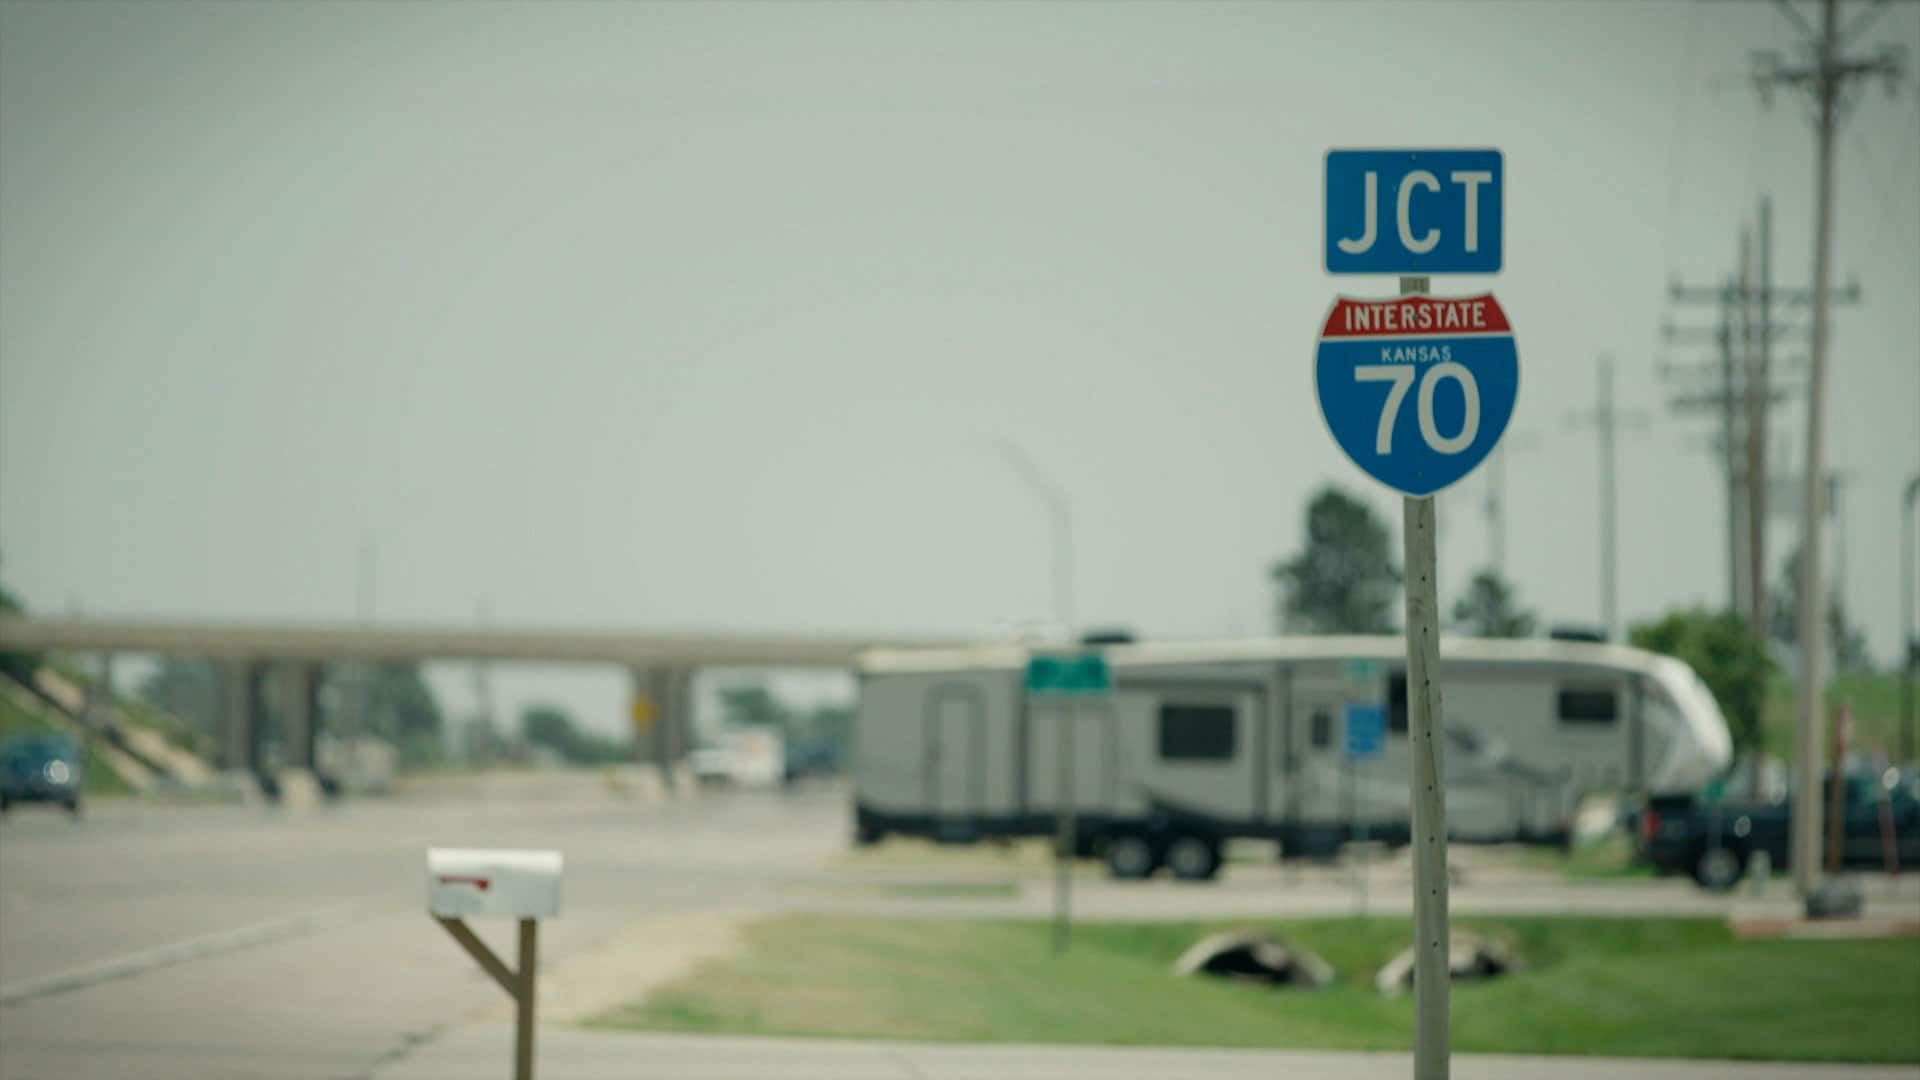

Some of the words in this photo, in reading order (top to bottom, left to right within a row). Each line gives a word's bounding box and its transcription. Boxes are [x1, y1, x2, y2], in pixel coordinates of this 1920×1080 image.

[1338, 171, 1492, 253] JCT
[1346, 303, 1486, 330] INTERSTATE
[1382, 346, 1451, 362] KANSAS
[1355, 362, 1480, 454] 70
